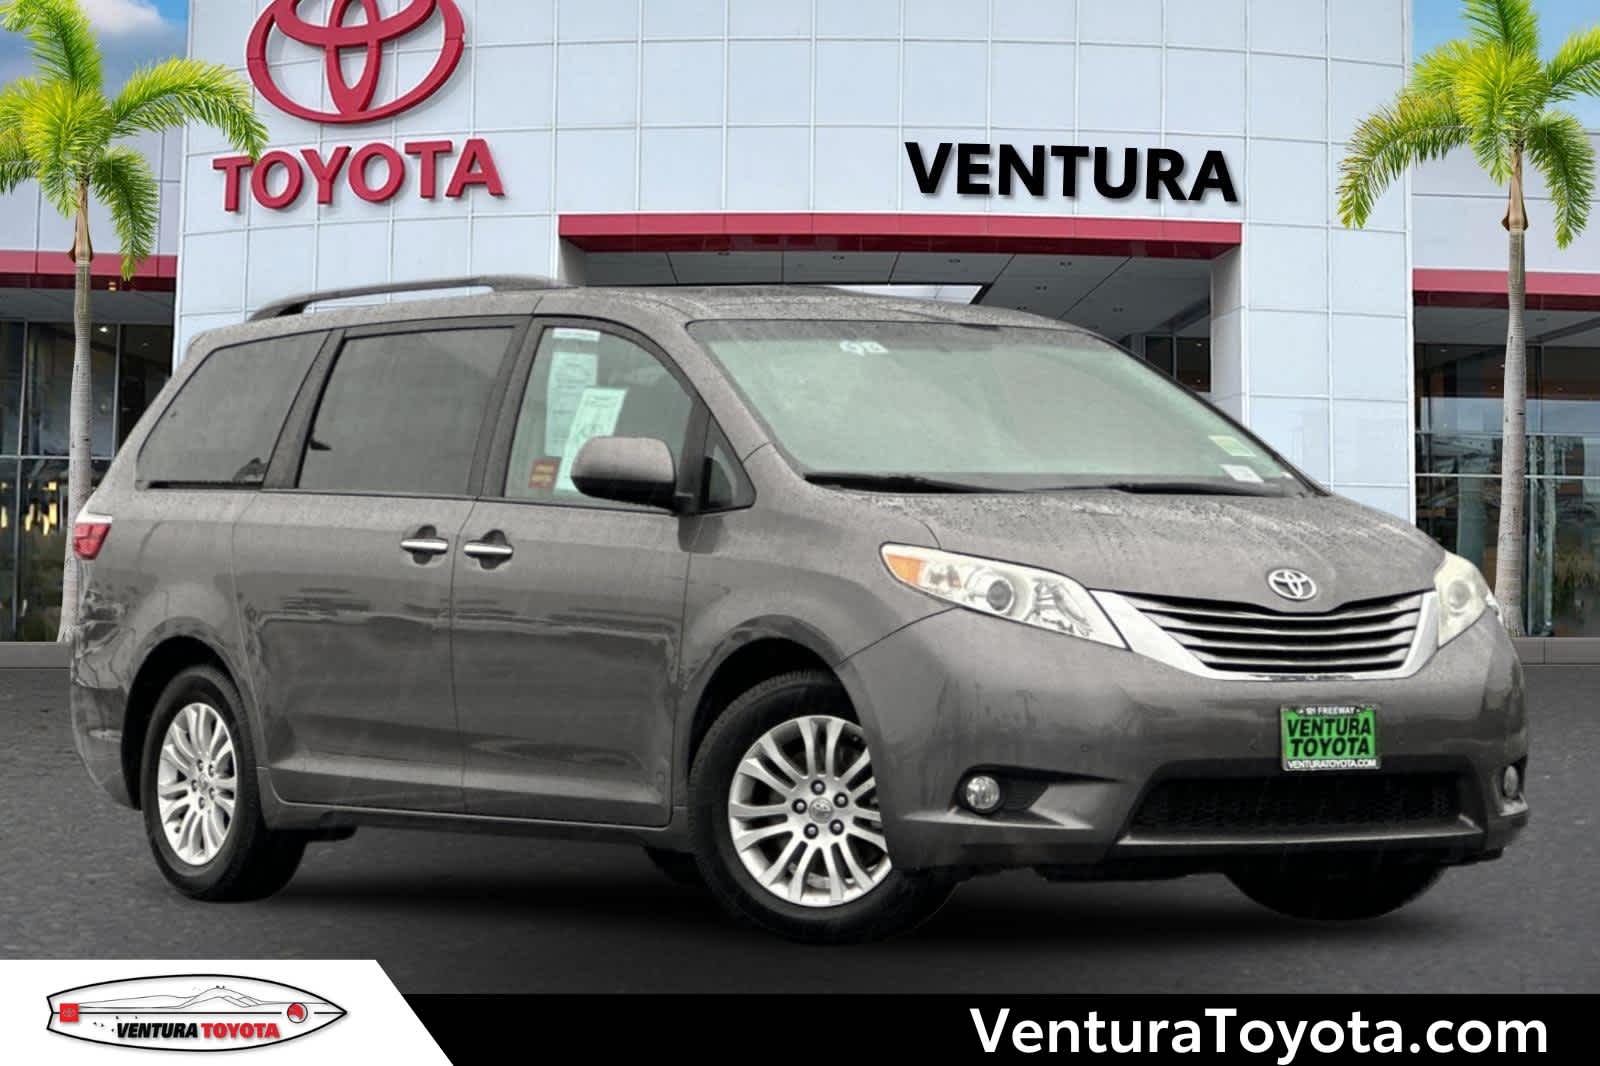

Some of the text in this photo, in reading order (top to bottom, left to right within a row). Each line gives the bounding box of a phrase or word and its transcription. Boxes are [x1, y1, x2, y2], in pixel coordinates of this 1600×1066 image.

[213, 139, 505, 212] TOYOTA
[904, 142, 1239, 202] VENTURA
[1318, 706, 1356, 715] FREEWAY
[1287, 718, 1372, 737] VENTURA
[1290, 737, 1370, 757] TOYOTA
[1287, 759, 1377, 769] VENTURATOYOTA.COM
